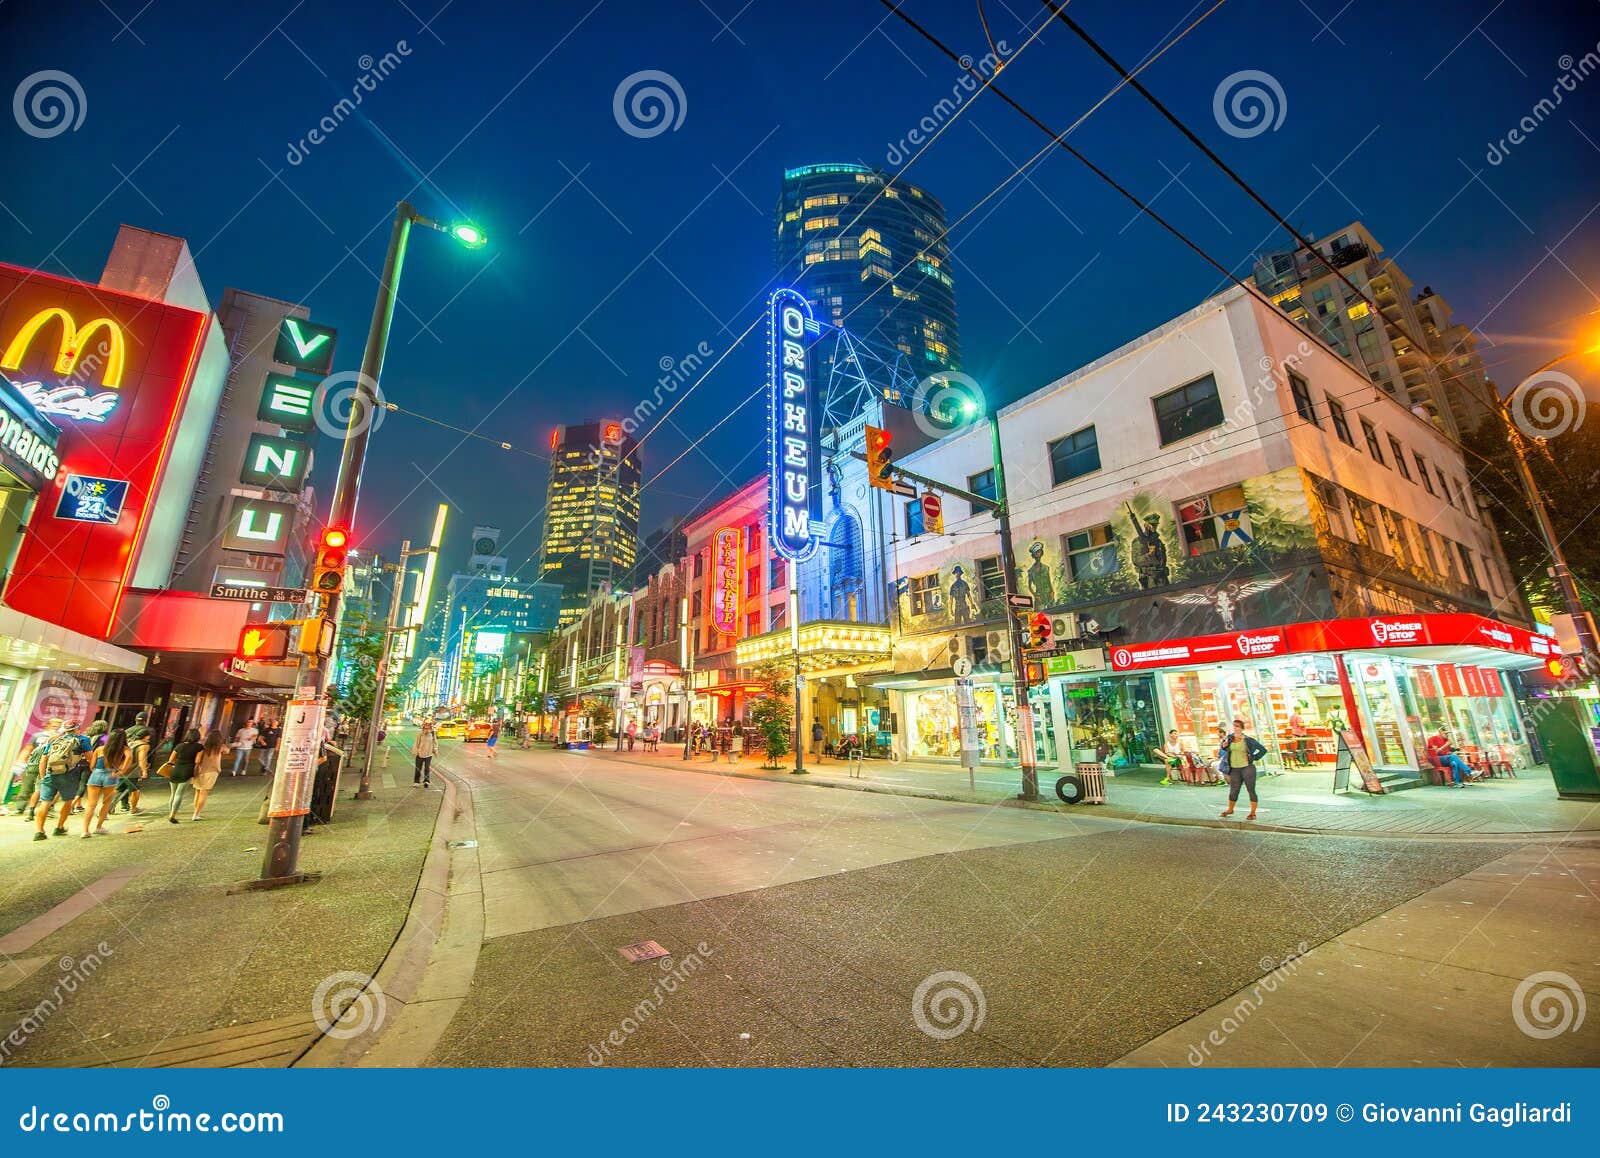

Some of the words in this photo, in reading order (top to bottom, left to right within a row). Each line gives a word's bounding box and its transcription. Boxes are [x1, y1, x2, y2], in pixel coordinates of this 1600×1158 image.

[782, 306, 809, 540] ORPHEUM
[76, 501, 102, 514] 24
[215, 586, 268, 600] Smithe
[1386, 622, 1422, 631] DÖNER
[1249, 635, 1280, 645] DÖNER
[1388, 631, 1416, 639] STOP
[1251, 643, 1274, 652] STOP
